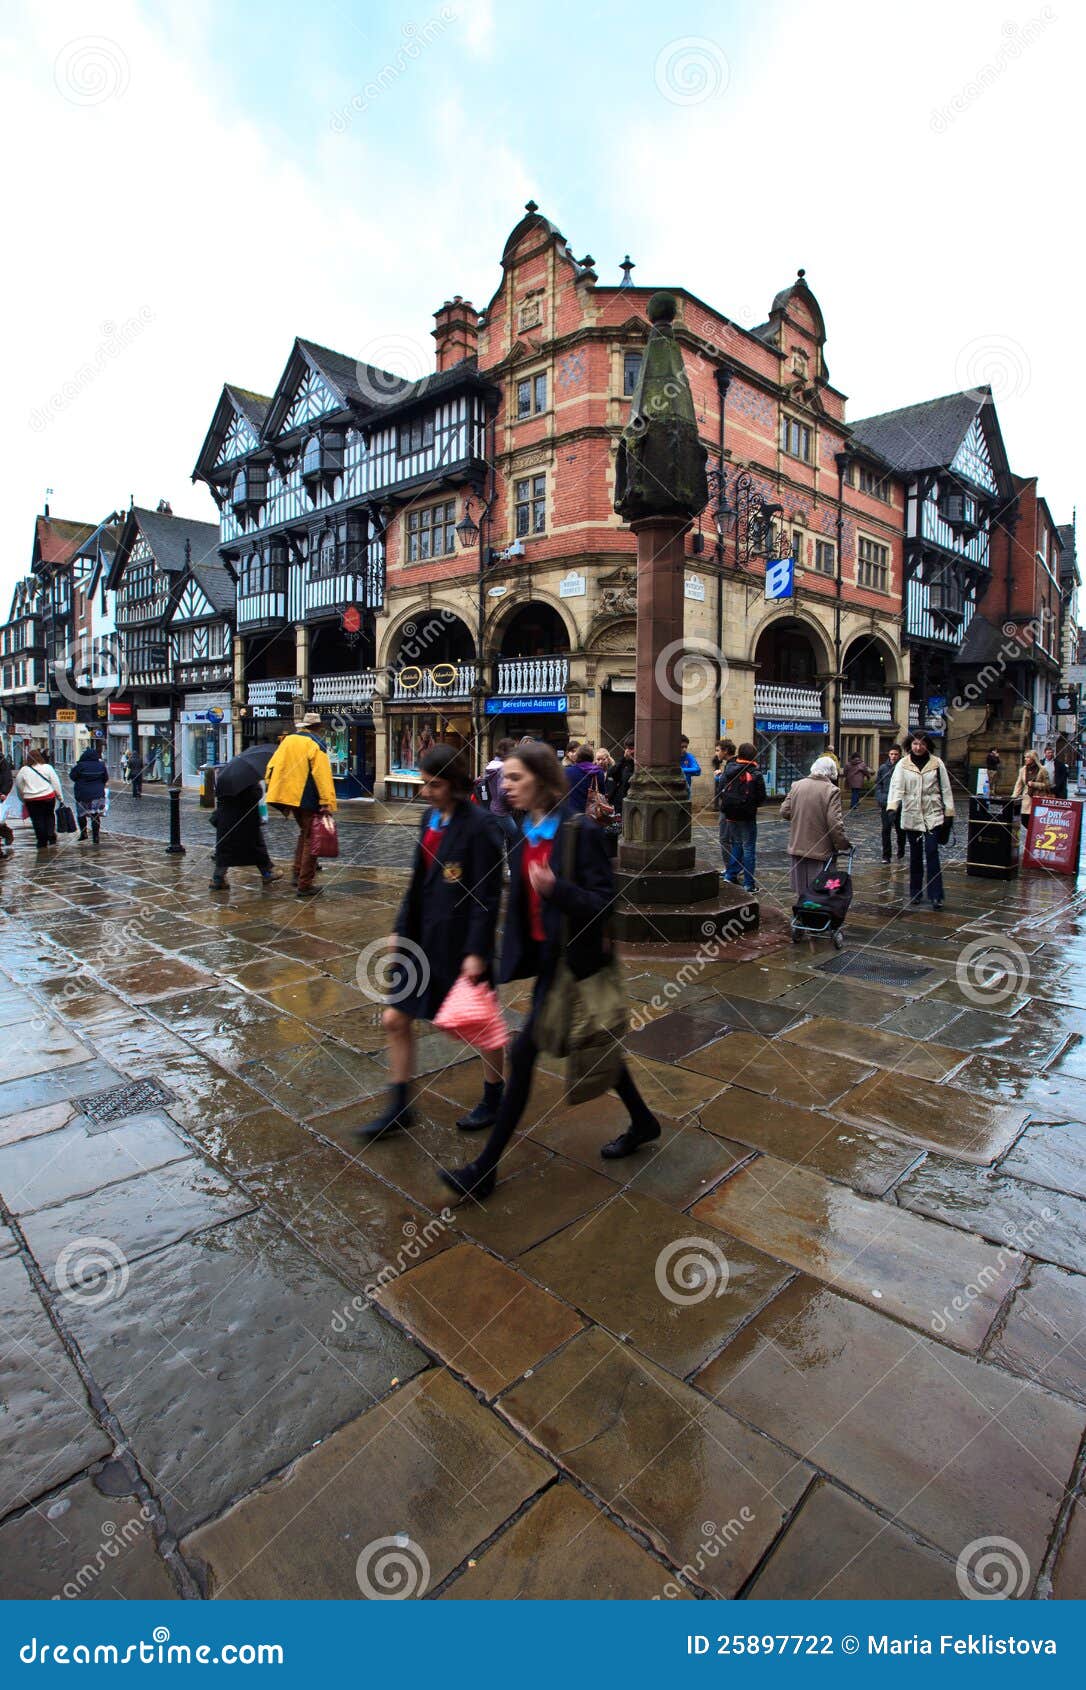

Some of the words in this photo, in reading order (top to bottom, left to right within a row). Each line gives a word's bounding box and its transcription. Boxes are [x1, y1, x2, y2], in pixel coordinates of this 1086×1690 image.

[766, 559, 791, 598] B
[502, 700, 532, 708] Beresford
[533, 699, 556, 707] Adams
[253, 706, 281, 718] Roha
[767, 721, 793, 730] Beresford
[1041, 799, 1072, 807] TIMPSON
[1047, 810, 1063, 819] DRY
[1039, 817, 1070, 828] CLEANING
